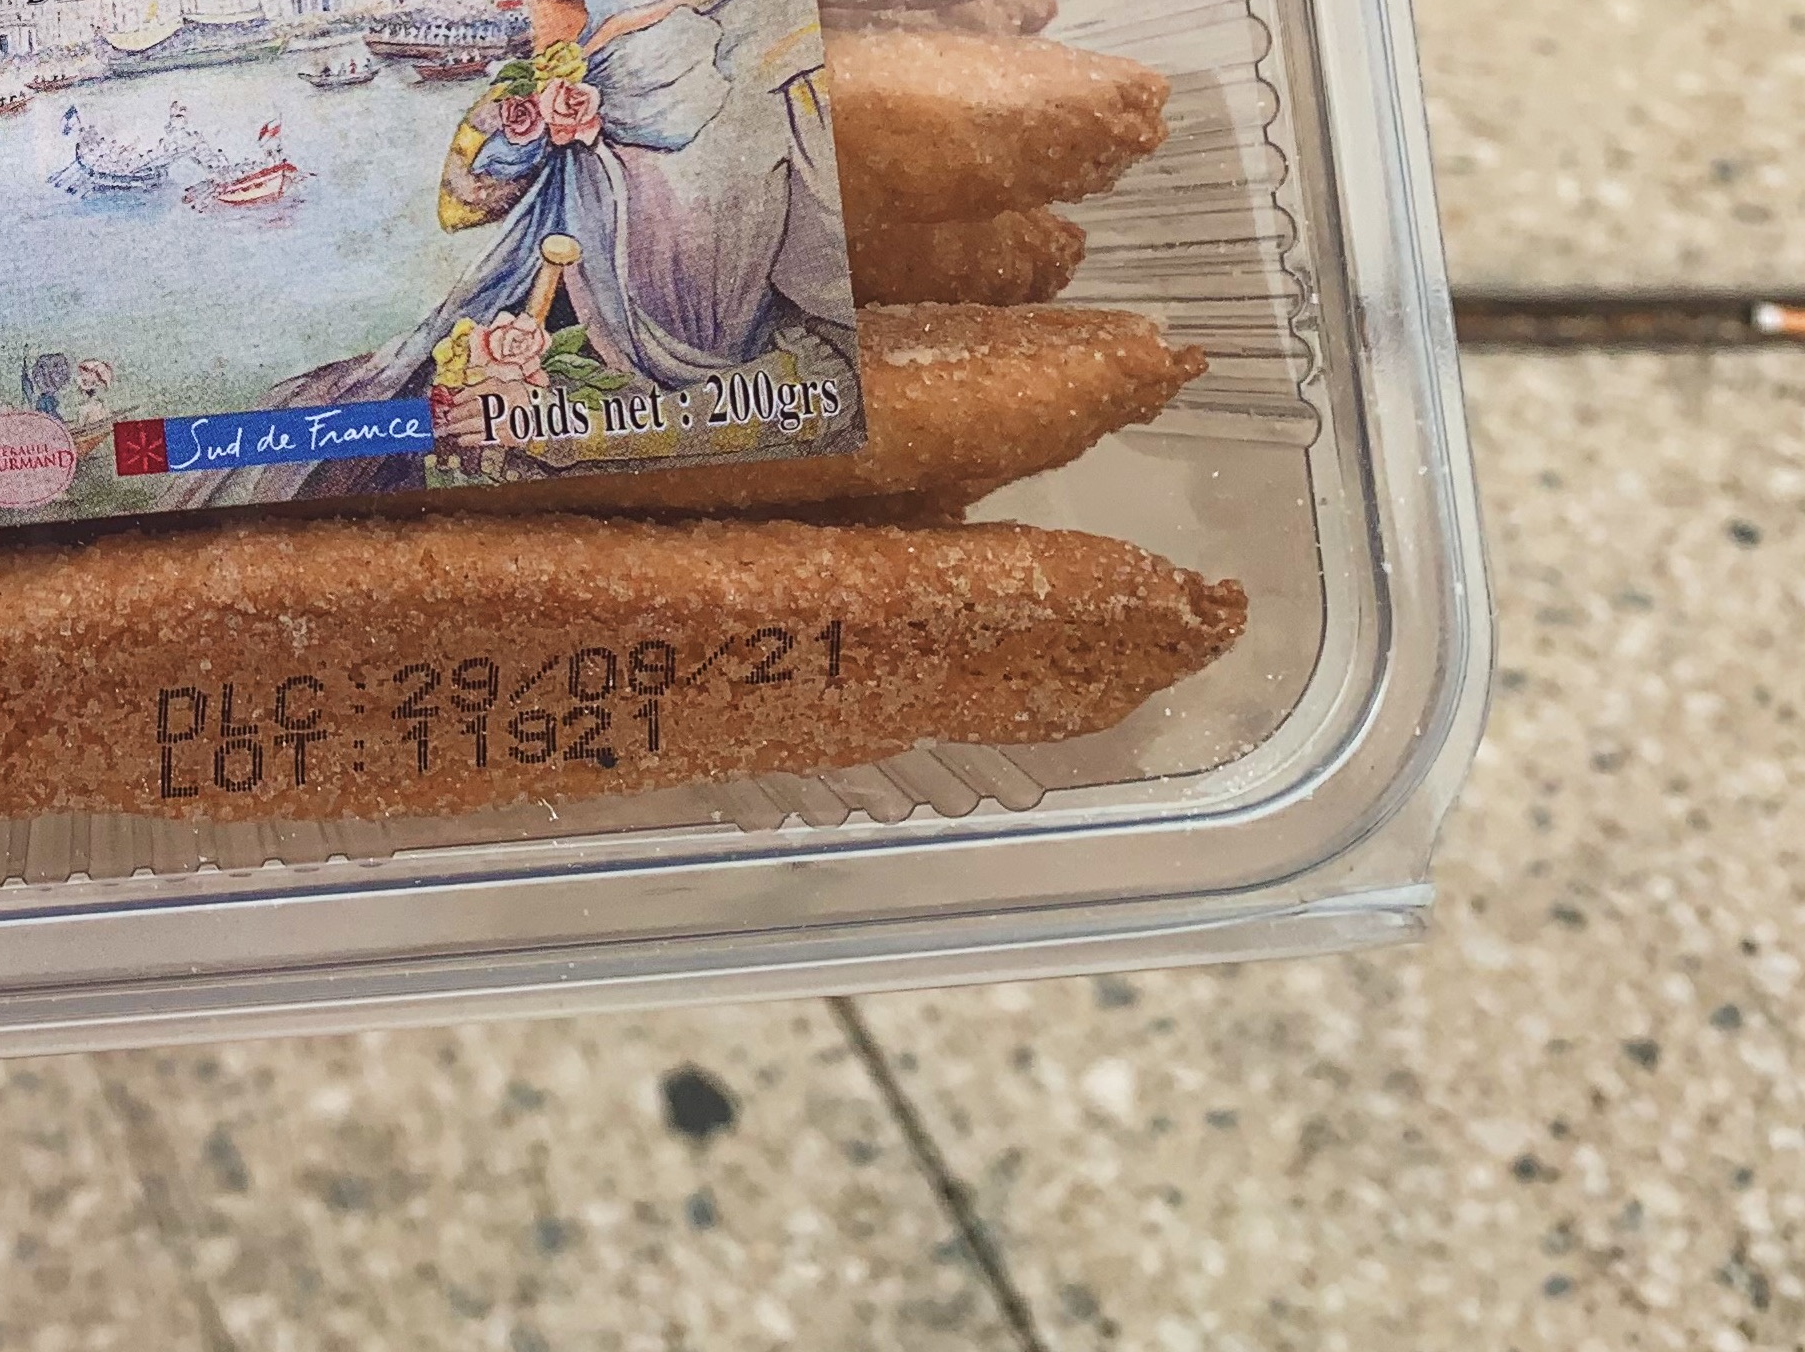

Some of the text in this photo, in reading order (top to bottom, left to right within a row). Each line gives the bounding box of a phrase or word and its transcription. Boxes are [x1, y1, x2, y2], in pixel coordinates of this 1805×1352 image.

[168, 408, 432, 470] Sud de France
[478, 386, 590, 442] Poids
[602, 386, 665, 433] net
[705, 369, 841, 432] 200grs
[160, 729, 328, 798] LOT
